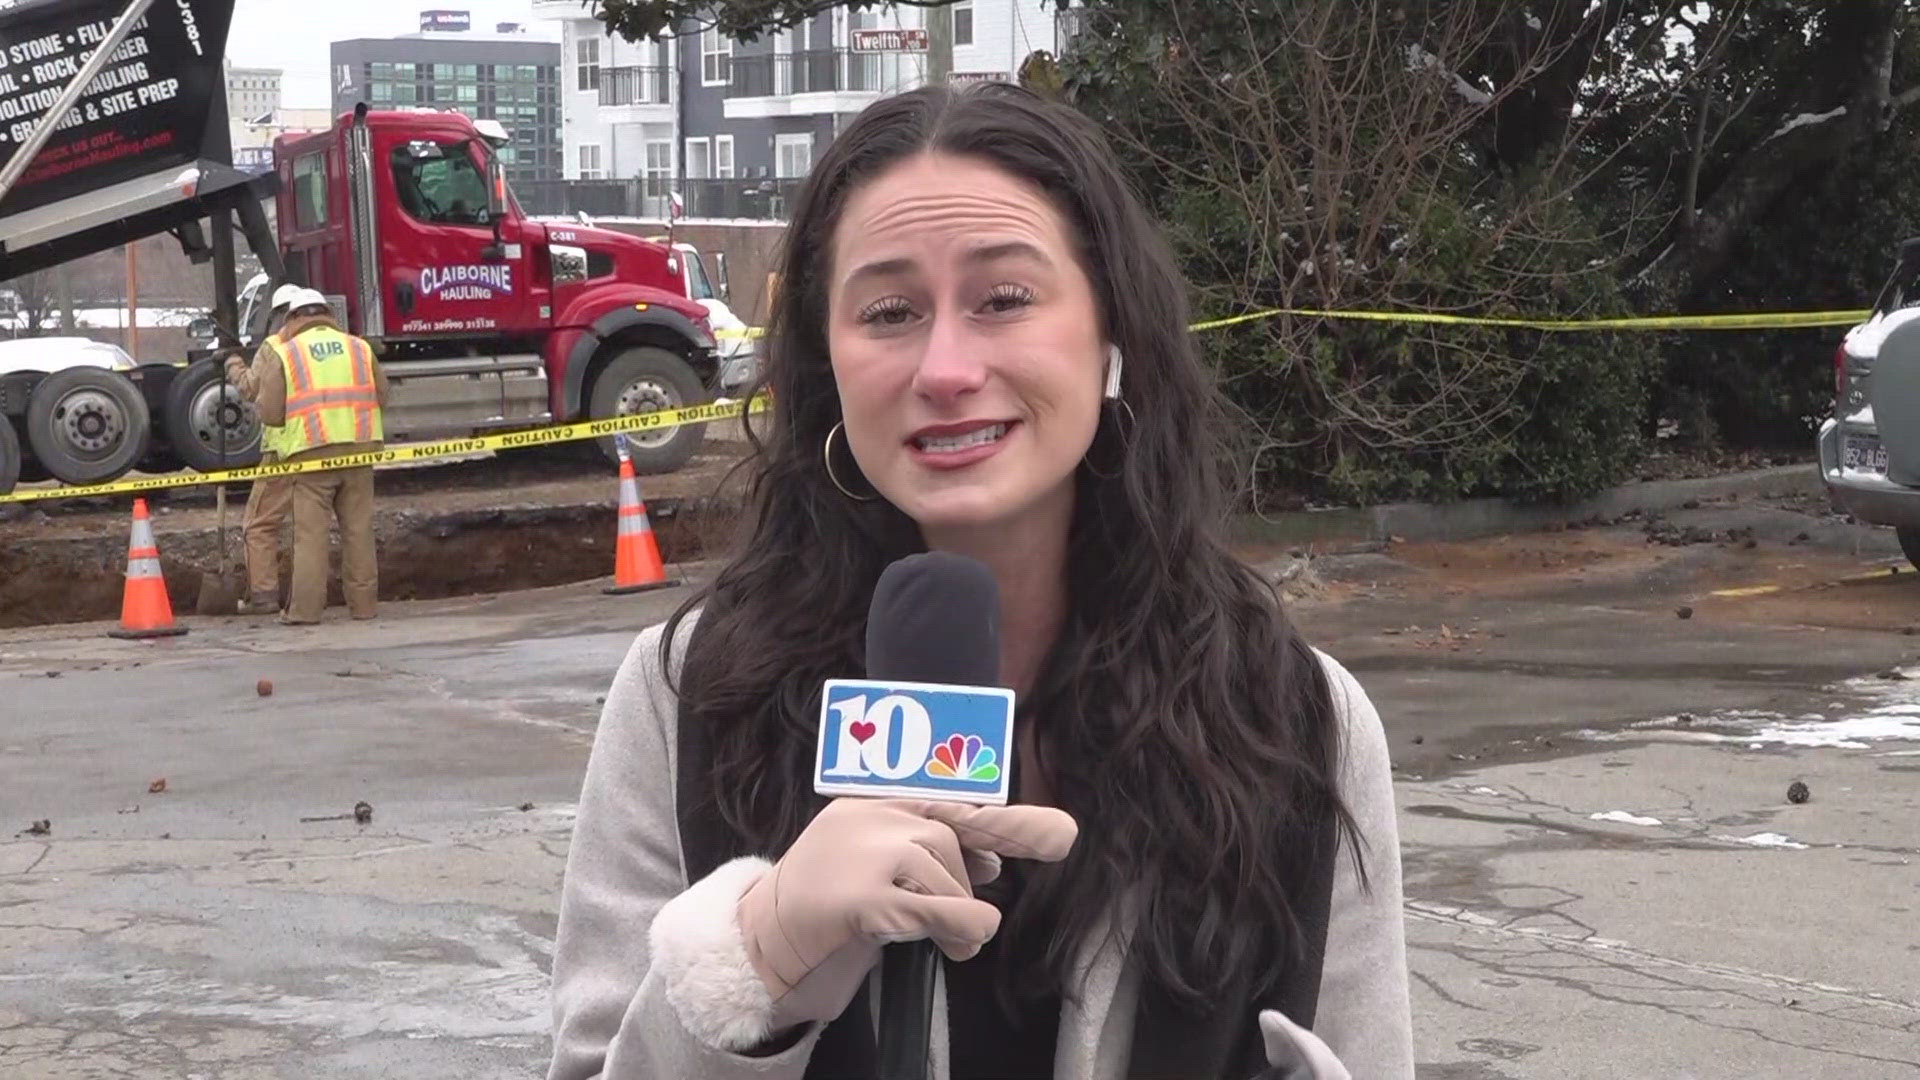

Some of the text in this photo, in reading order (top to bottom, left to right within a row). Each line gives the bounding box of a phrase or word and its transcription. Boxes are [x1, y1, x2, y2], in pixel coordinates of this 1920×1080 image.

[9, 33, 65, 64] STONE
[77, 21, 109, 46] FILL
[854, 32, 901, 49] Twelfth
[32, 54, 79, 84] ROCK
[80, 36, 149, 65] SNGER
[0, 85, 63, 121] OLITION
[11, 78, 179, 143] GRNG & SITE PREP
[421, 265, 511, 294] CLAIBORNE
[440, 286, 492, 300] HAULING
[309, 341, 344, 358] KUB
[590, 414, 661, 433] CAUTION
[502, 427, 573, 446] CAUTION
[413, 439, 485, 457] CAUTION
[321, 451, 396, 469] CAUTION
[133, 472, 210, 488] CAUTION
[228, 463, 303, 479] CAUTION
[822, 693, 932, 780] 10
